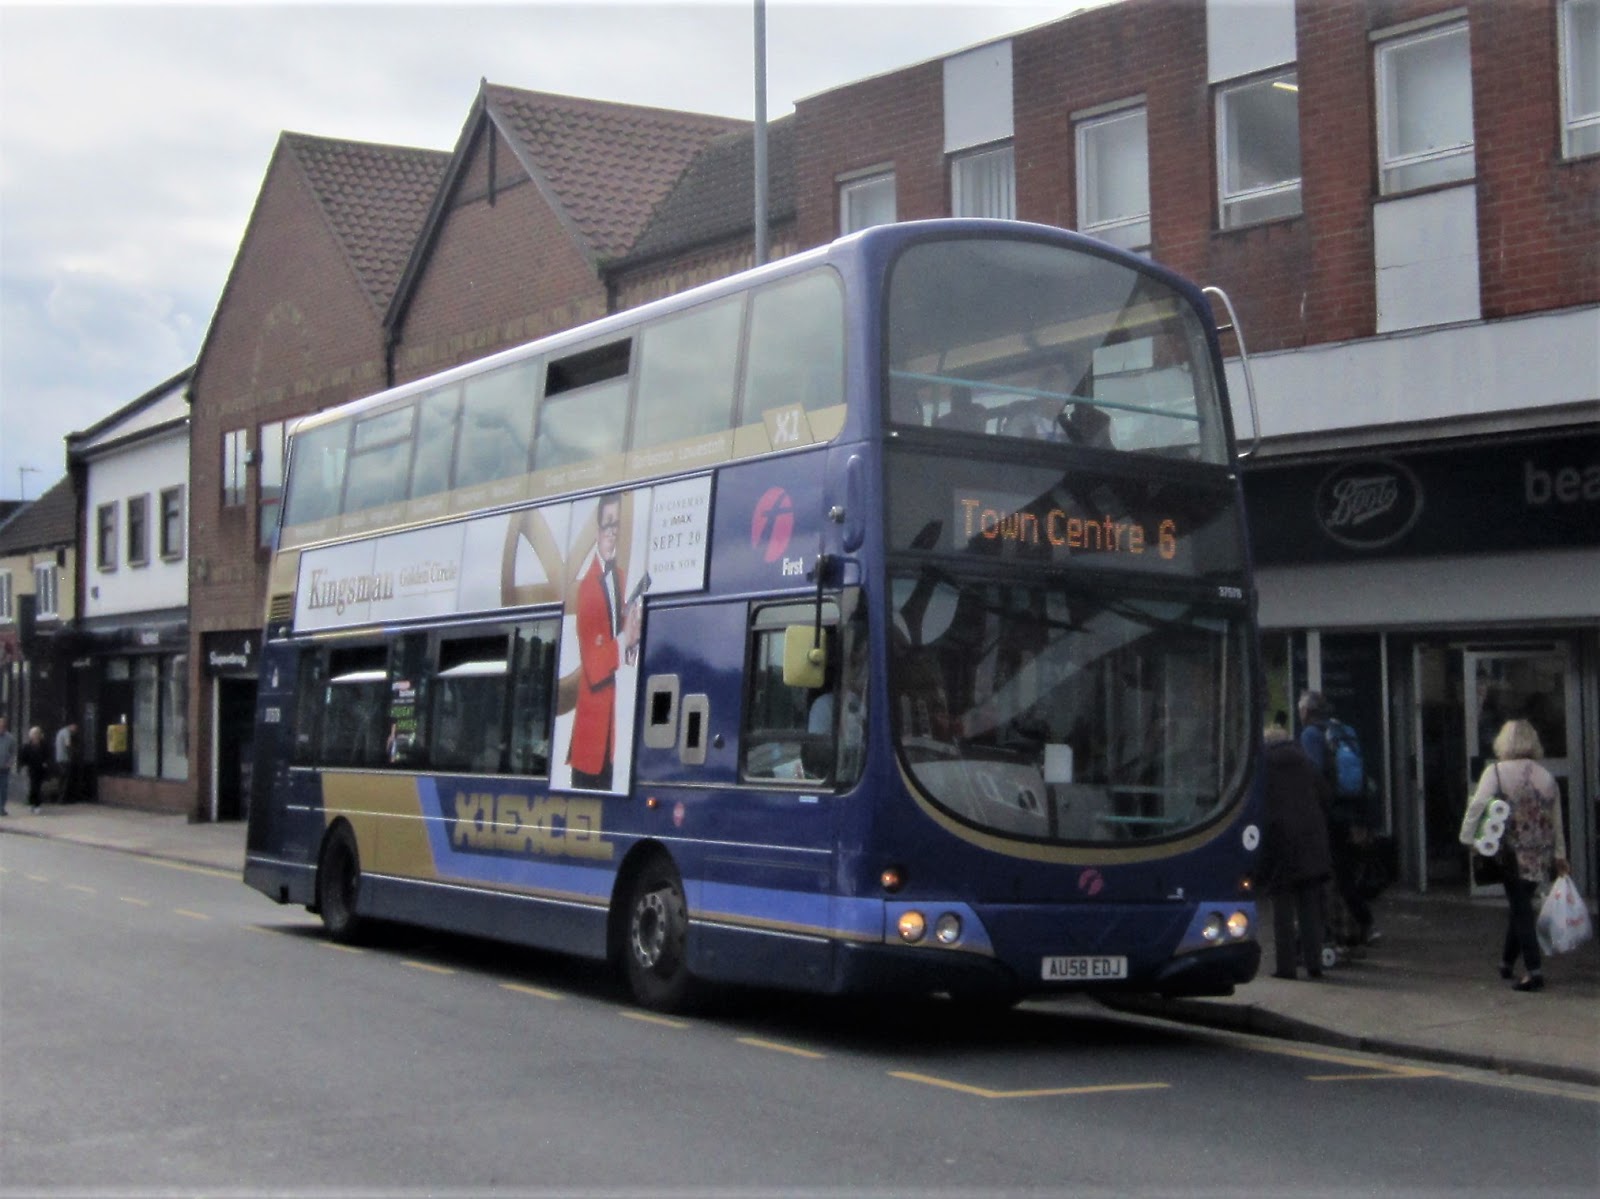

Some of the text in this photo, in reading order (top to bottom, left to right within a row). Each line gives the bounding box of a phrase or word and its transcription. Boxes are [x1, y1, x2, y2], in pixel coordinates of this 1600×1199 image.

[960, 498, 1177, 560] Town Centre 6
[653, 531, 702, 550] SEPT 20
[782, 556, 804, 576] First
[307, 568, 394, 616] Kingsman
[1049, 959, 1122, 977] AU58 EDJ
